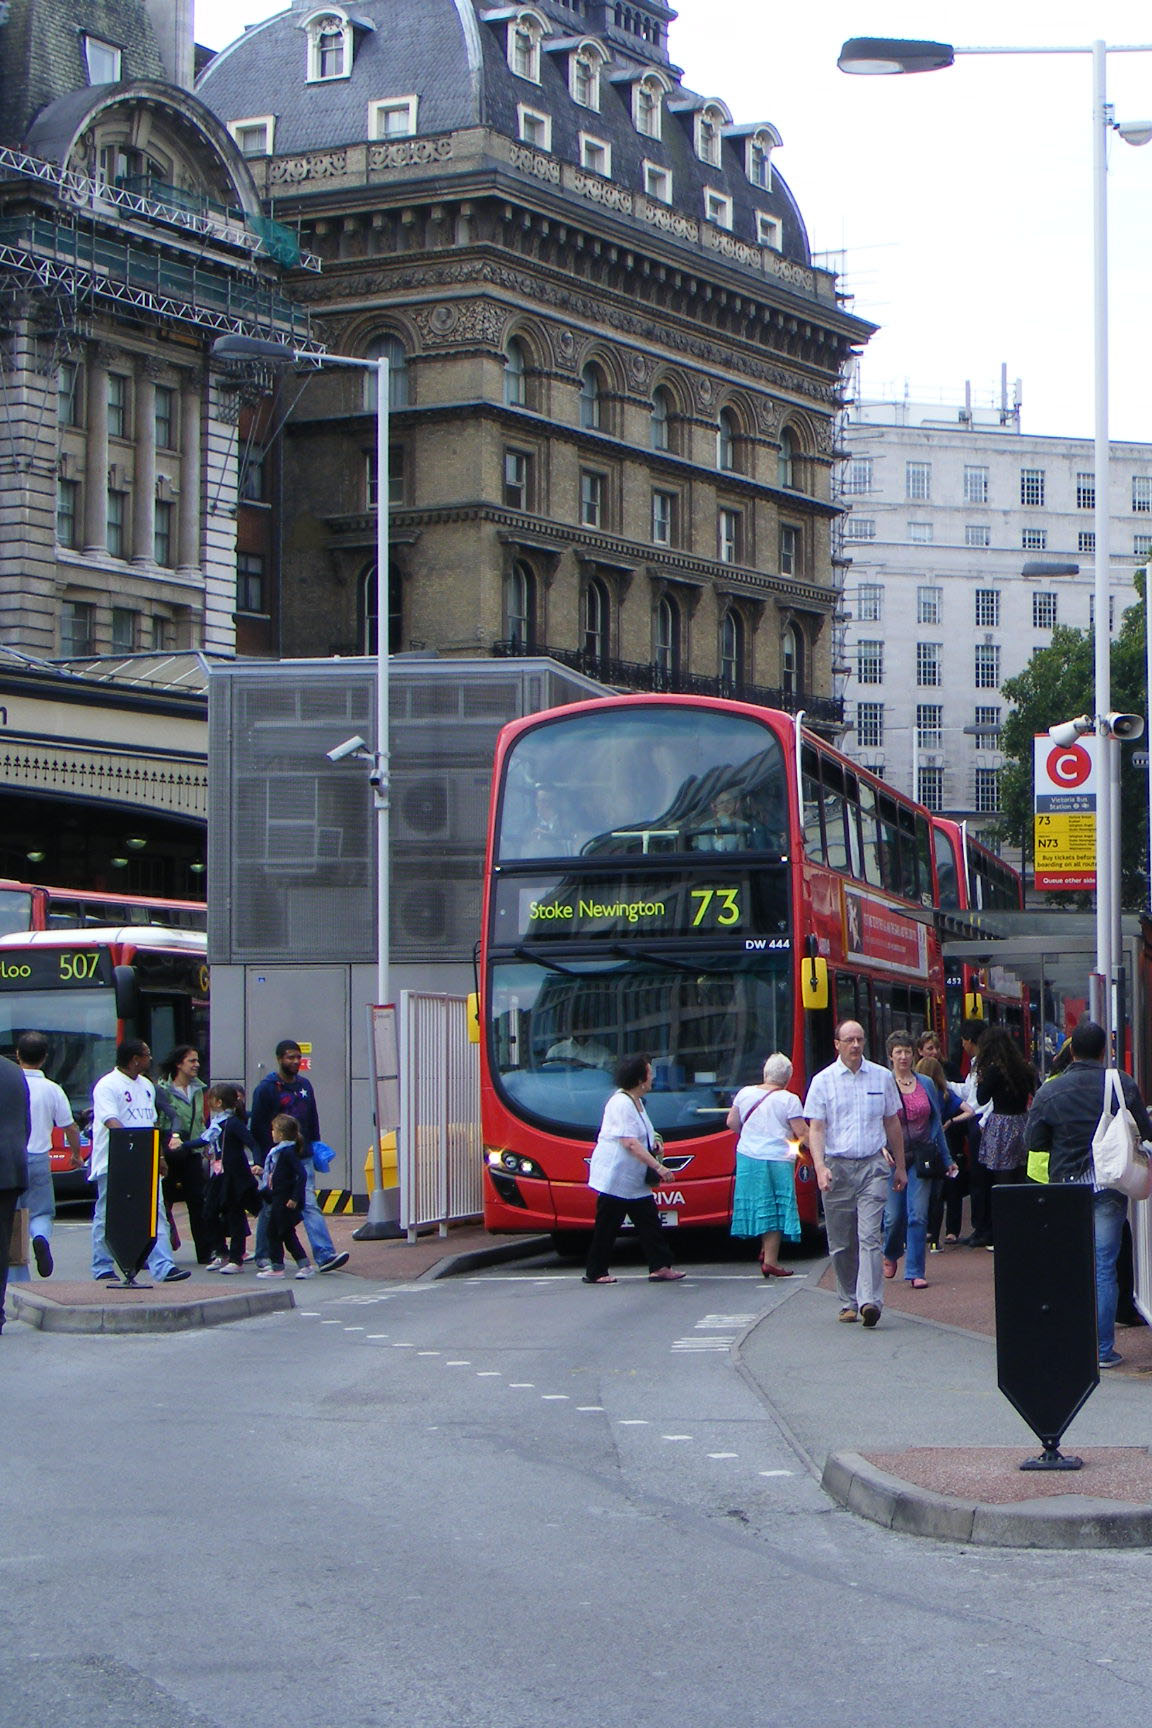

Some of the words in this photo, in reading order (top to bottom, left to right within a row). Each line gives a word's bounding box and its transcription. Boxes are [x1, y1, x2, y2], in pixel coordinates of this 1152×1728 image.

[1056, 754, 1078, 780] C
[1038, 816, 1051, 826] 73
[1038, 839, 1059, 848] N73
[529, 901, 574, 920] Stoke
[578, 899, 665, 922] Newington
[690, 888, 740, 926] 73
[745, 939, 766, 950] DW
[768, 938, 791, 949] 444
[60, 953, 100, 980] 507
